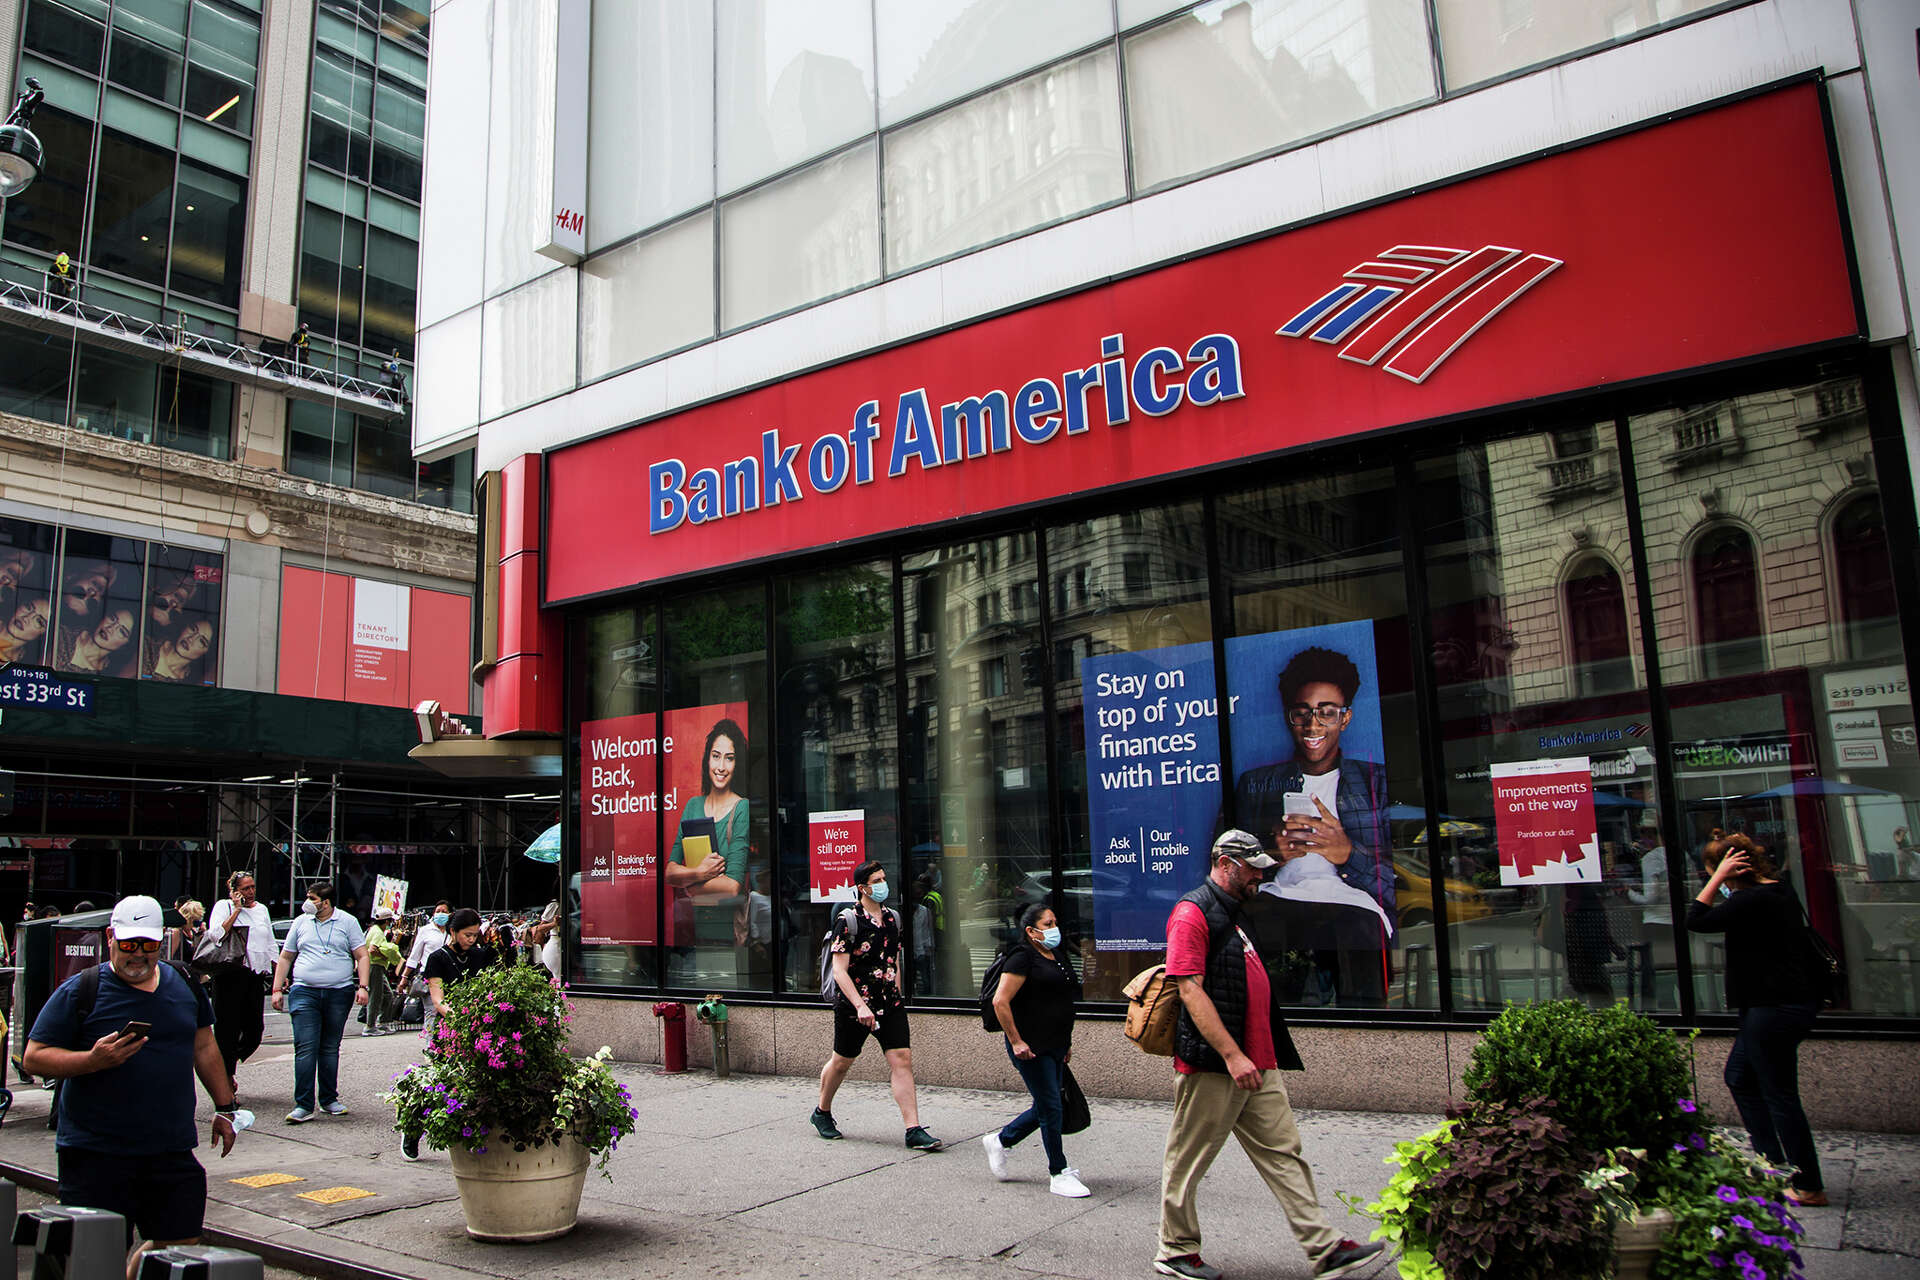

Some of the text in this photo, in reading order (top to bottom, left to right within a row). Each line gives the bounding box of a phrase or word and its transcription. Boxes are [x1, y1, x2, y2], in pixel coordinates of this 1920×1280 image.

[556, 207, 584, 236] H&M
[649, 333, 1246, 535] Bank of America
[358, 623, 387, 632] TENANT
[12, 668, 49, 680] 101 161
[1096, 669, 1185, 699] Stay on
[0, 682, 86, 707] st 33rd St
[1097, 695, 1240, 732] top of your
[591, 736, 673, 760] Welcome
[1099, 732, 1197, 759] finances
[1539, 735, 1566, 749] Bank
[592, 763, 635, 788] Back,
[1100, 763, 1153, 790] with
[1161, 760, 1220, 786] Erica
[1498, 782, 1587, 799] Improvements
[591, 787, 678, 816] Students!
[1509, 799, 1578, 812] on the way
[824, 828, 849, 840] We're
[1150, 829, 1172, 842] Our
[817, 843, 857, 856] still open
[1110, 837, 1131, 850] Ask
[1151, 843, 1189, 856] mobile
[594, 856, 607, 865] Ask
[617, 854, 656, 866] Banking for
[1105, 852, 1137, 864] about
[591, 867, 610, 877] about
[617, 866, 647, 876] students
[1152, 861, 1173, 874] app
[65, 945, 95, 956] DESI TALK
